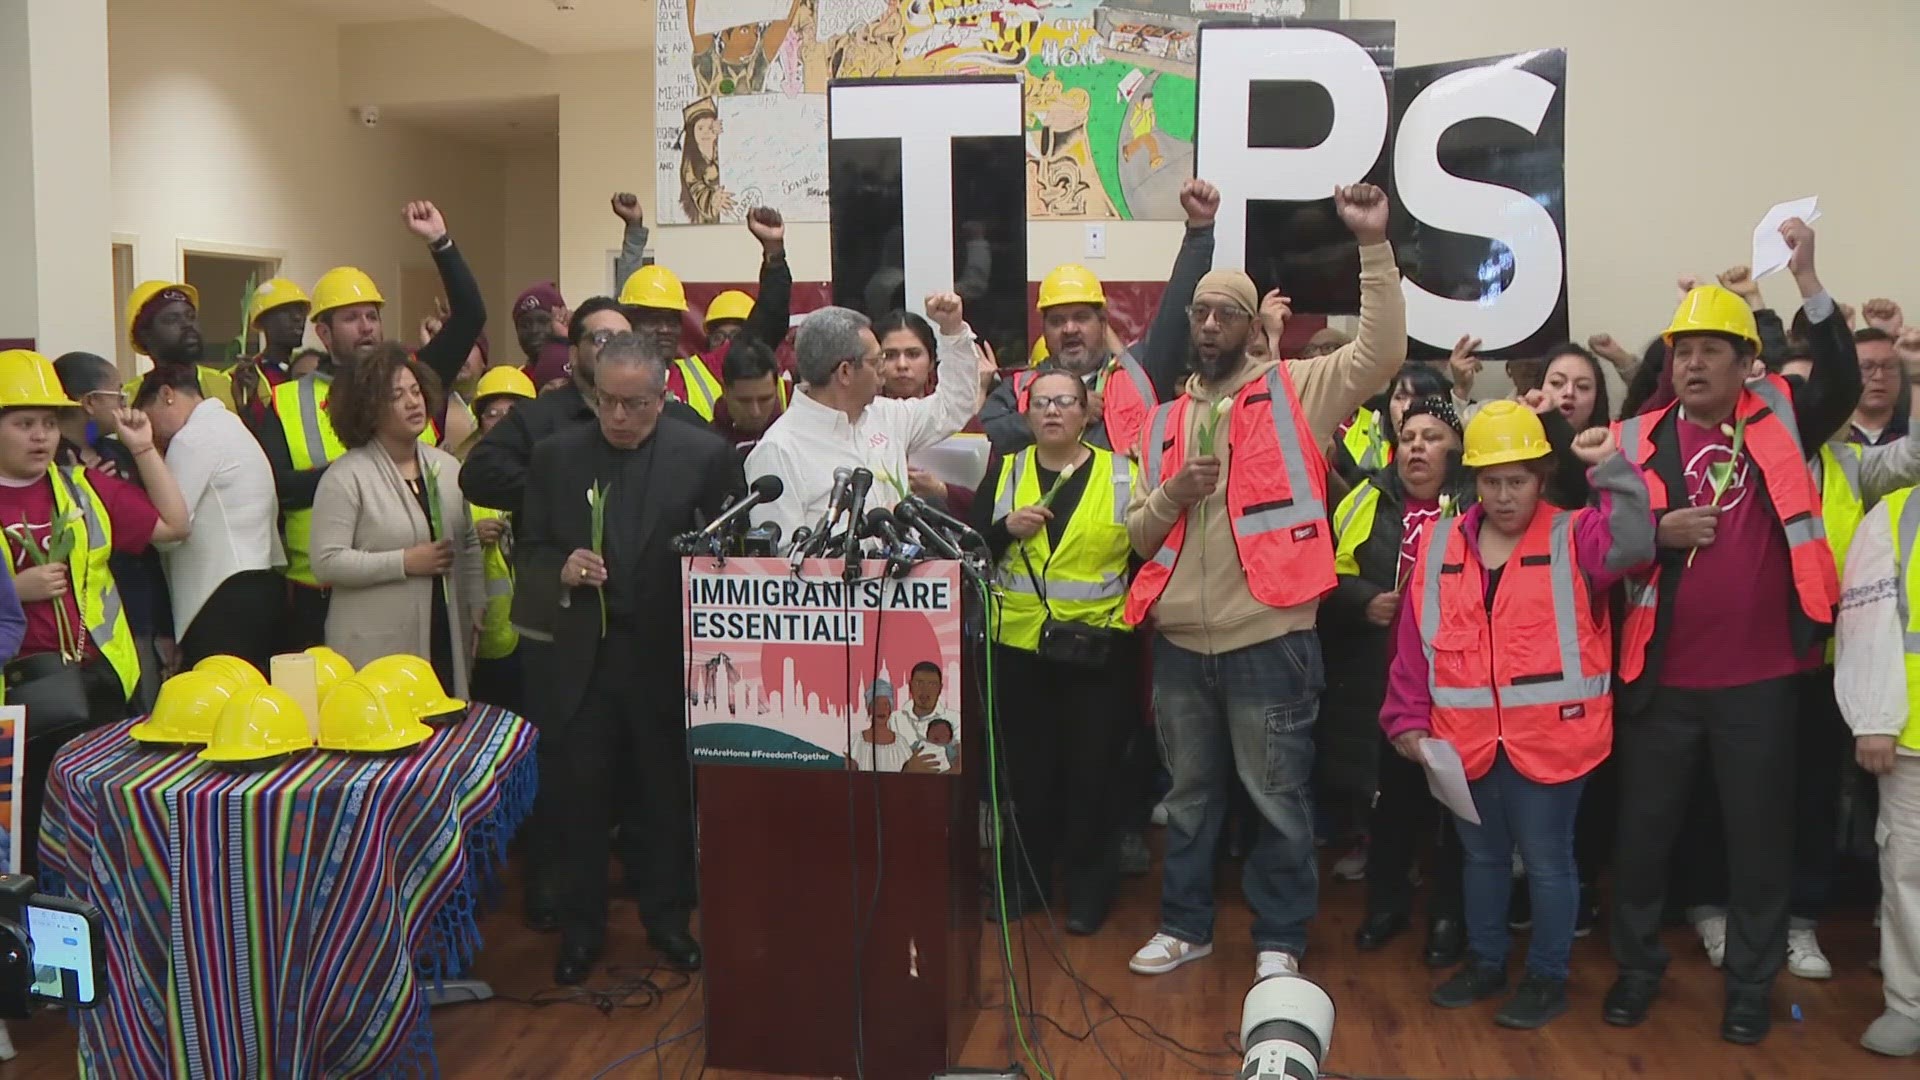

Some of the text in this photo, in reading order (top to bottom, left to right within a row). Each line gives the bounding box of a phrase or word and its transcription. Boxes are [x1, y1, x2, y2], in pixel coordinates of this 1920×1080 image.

[658, 21, 680, 32] TELL
[658, 84, 695, 100] MIGHTY
[831, 28, 1563, 352] T P S
[692, 578, 948, 610] IMMIGRANTS ARE
[692, 611, 858, 642] ESSENTIAL!
[694, 748, 830, 762] #WeAreHome #FreedomTogether
